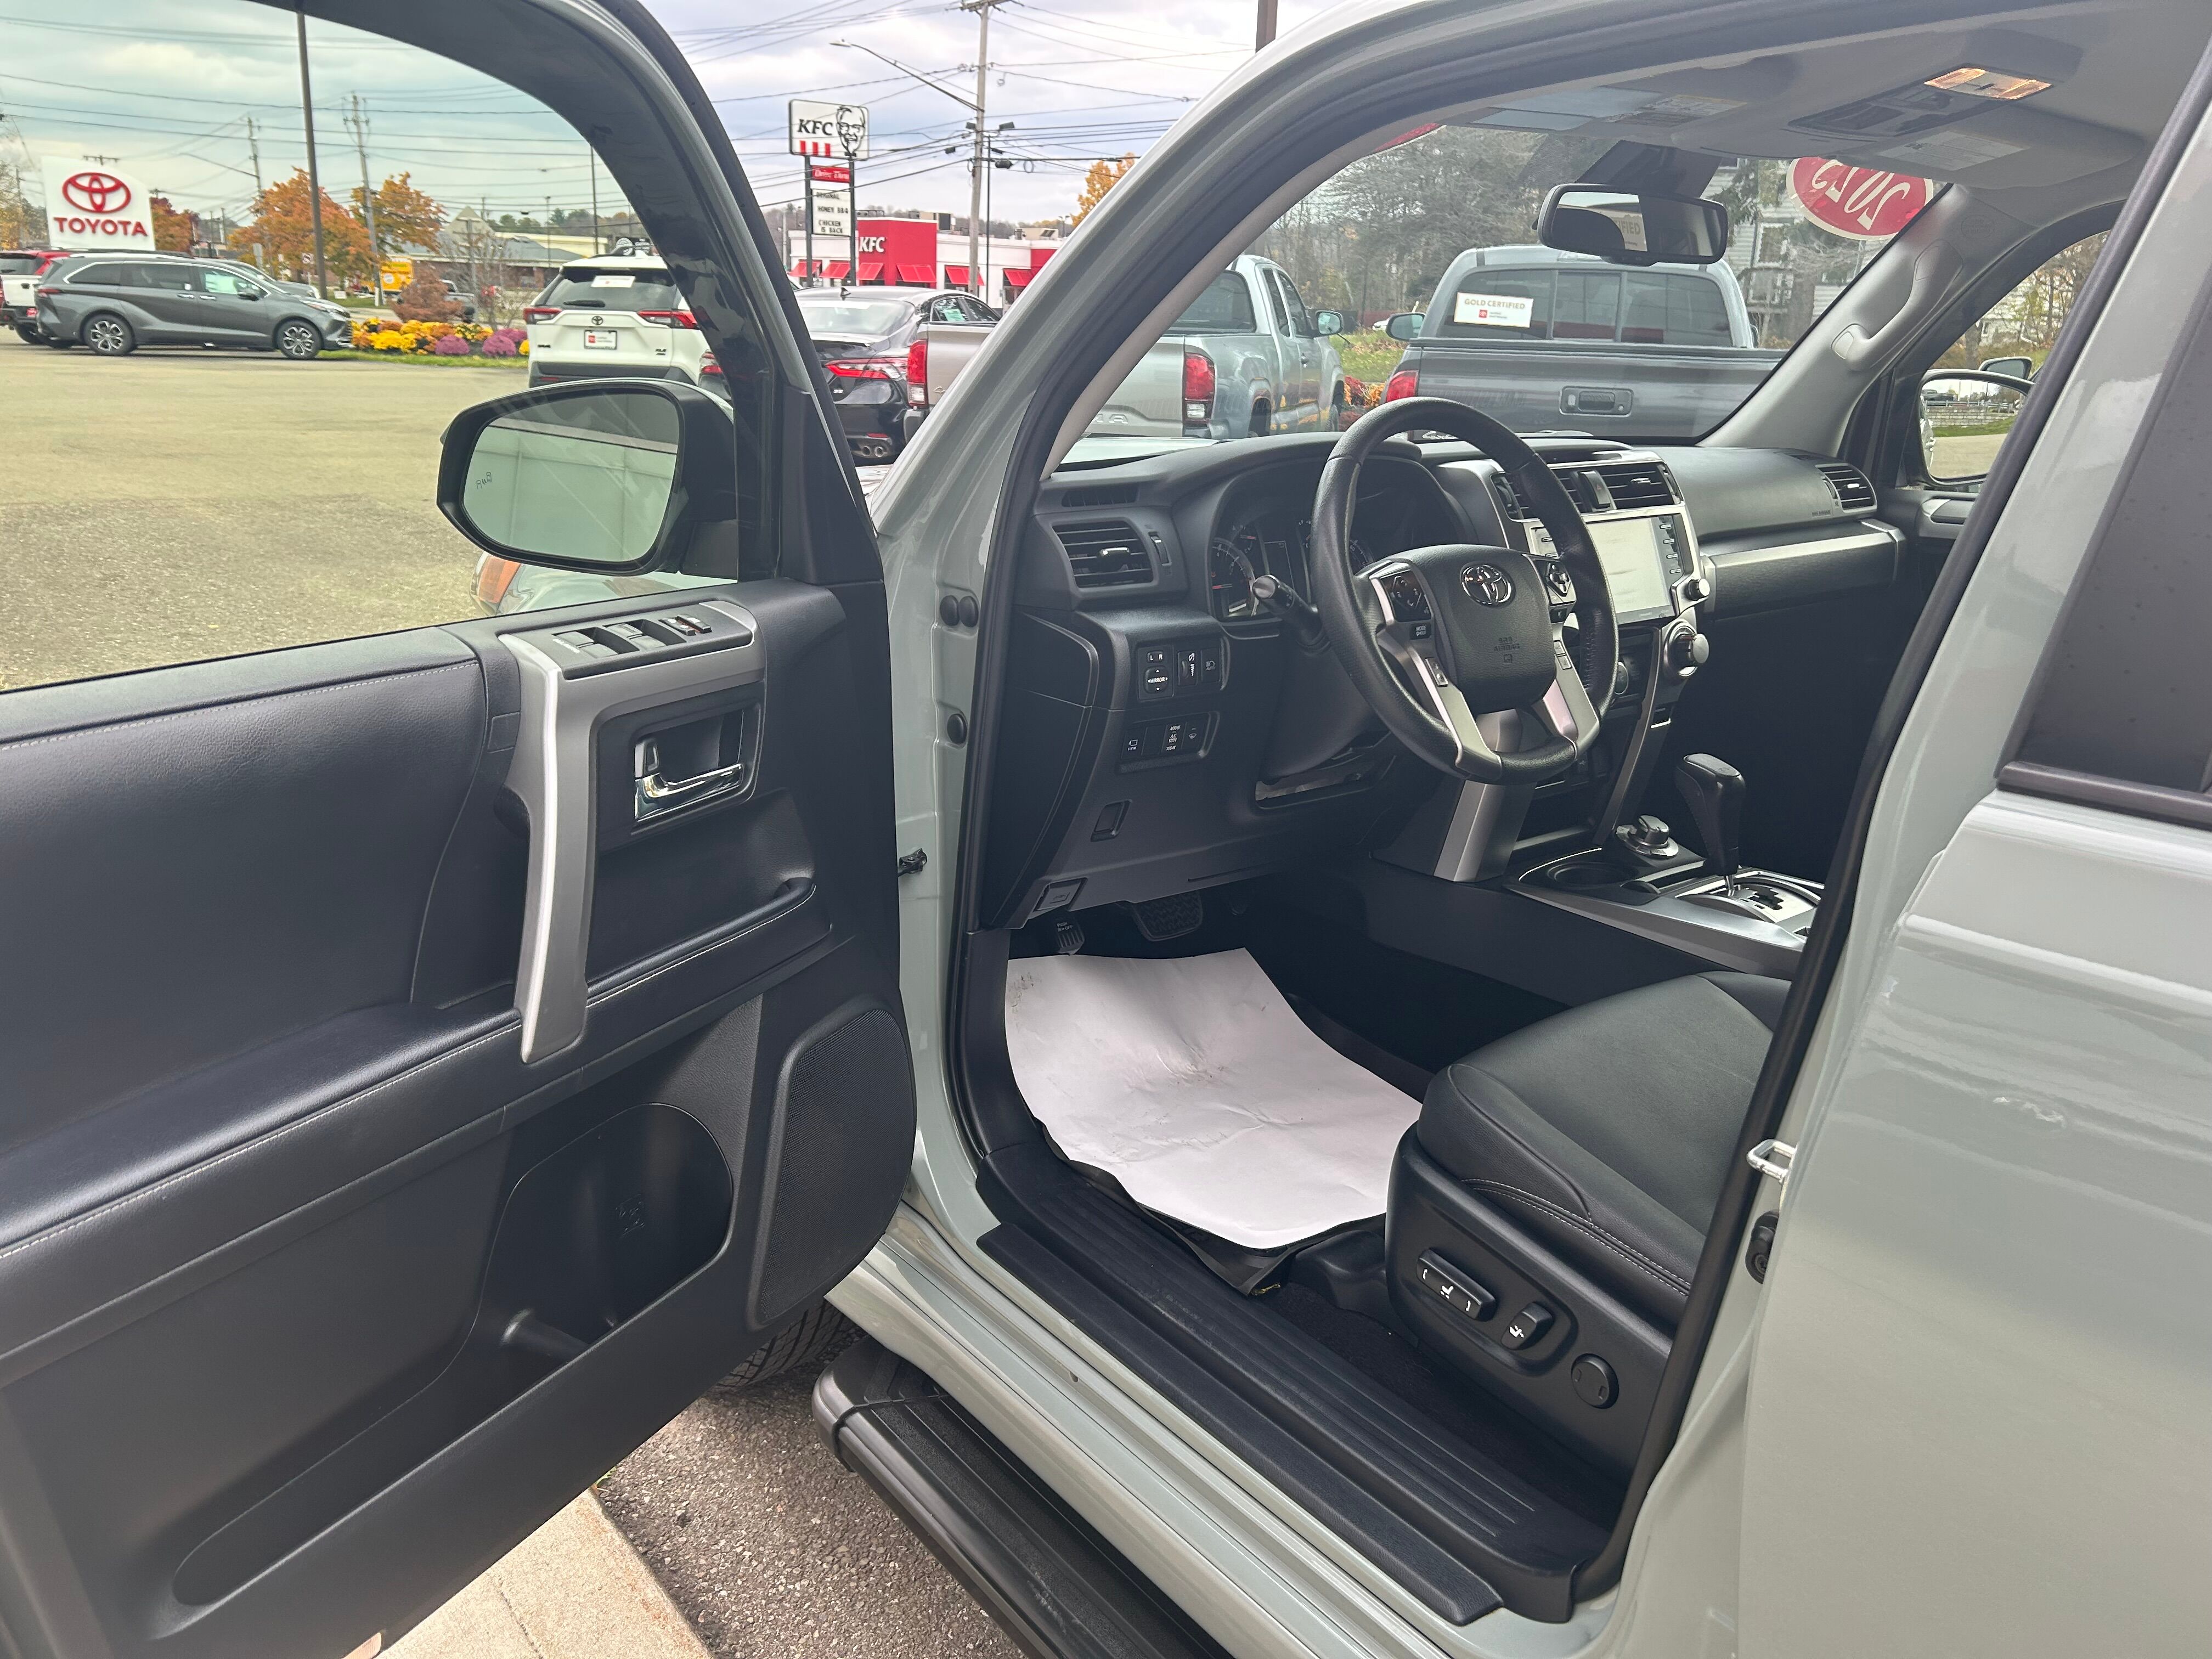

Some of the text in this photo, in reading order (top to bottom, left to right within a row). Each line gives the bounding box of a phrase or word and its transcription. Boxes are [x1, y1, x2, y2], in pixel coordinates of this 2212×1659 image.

[797, 119, 833, 136] KFC
[53, 217, 148, 237] TOYOTA
[859, 236, 885, 252] KFC
[1487, 300, 1525, 309] CERTIFIED
